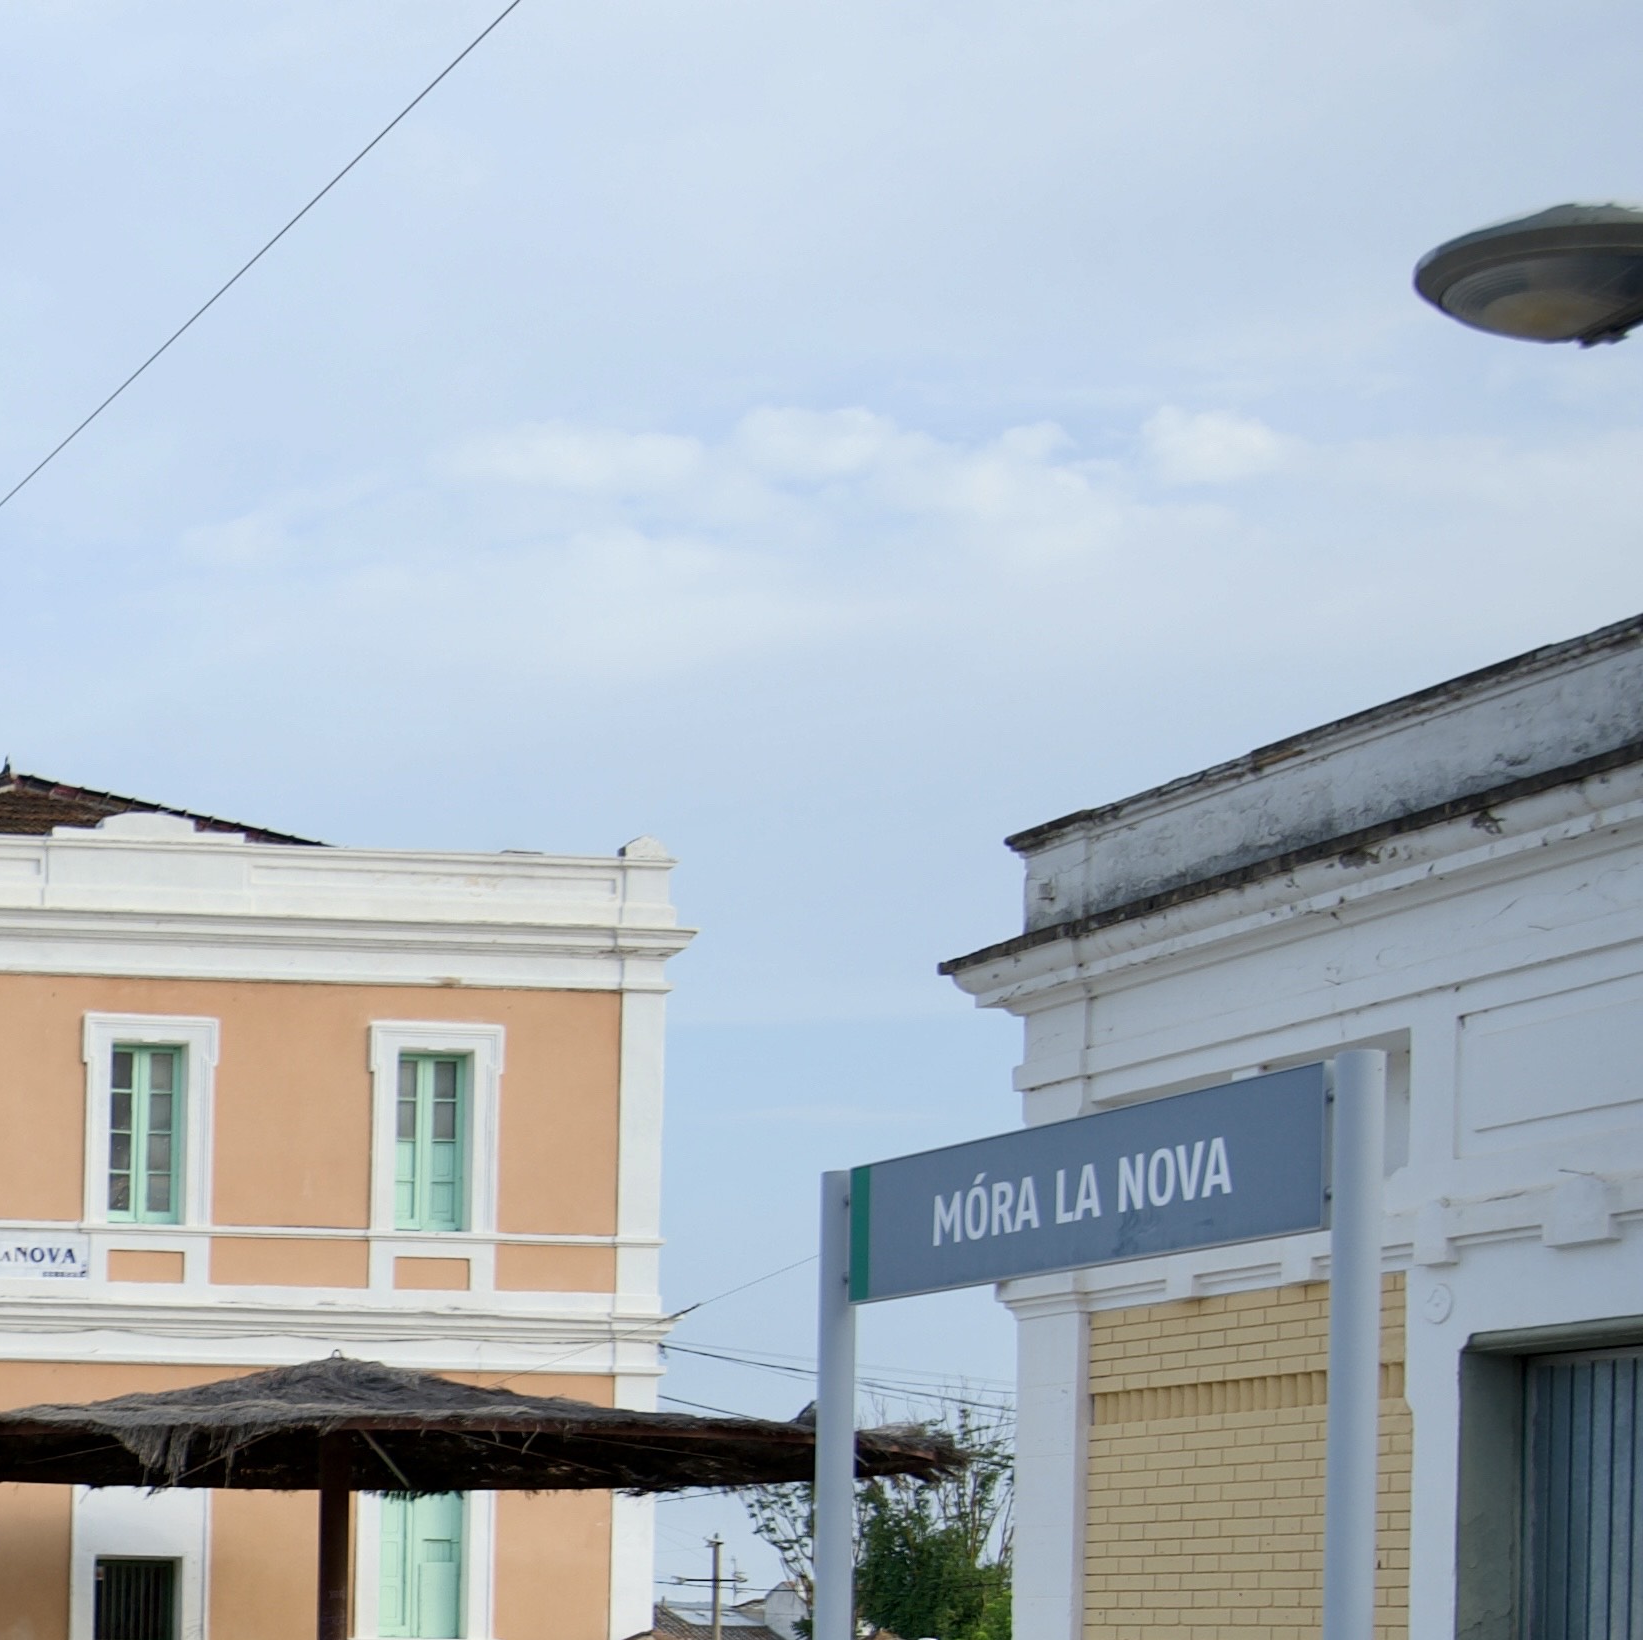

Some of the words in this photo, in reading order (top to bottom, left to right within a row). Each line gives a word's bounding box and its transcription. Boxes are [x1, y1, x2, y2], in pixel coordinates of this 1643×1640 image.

[931, 1172, 1040, 1247] MÓRA
[1055, 1162, 1102, 1225] LA
[1117, 1136, 1233, 1214] NOVA
[14, 1246, 76, 1265] NOVA
